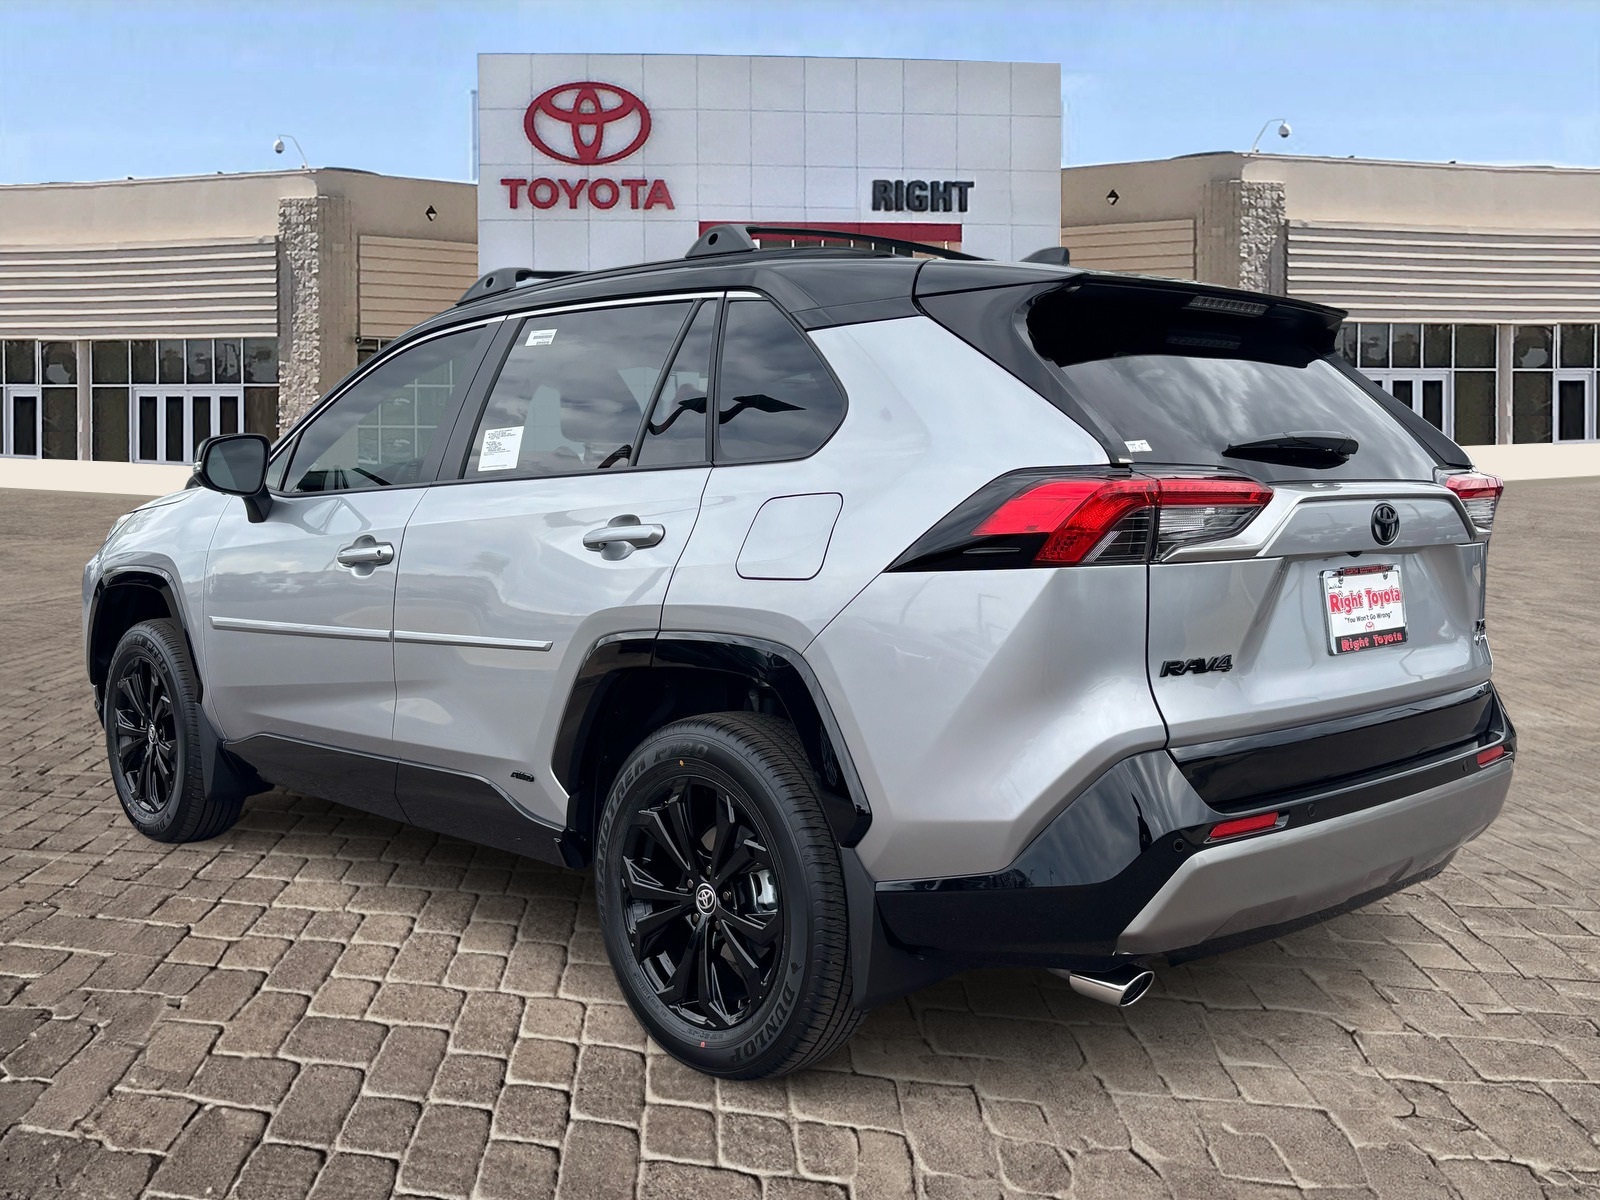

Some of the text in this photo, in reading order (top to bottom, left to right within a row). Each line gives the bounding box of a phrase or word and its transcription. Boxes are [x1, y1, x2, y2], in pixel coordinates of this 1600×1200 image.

[500, 177, 676, 210] TOYOTA
[871, 179, 975, 212] RIGHT
[1328, 586, 1401, 614] Right Toyota
[1341, 632, 1403, 651] Right Toyota
[1159, 654, 1233, 677] RAV4
[728, 980, 796, 1064] DUNLOP
